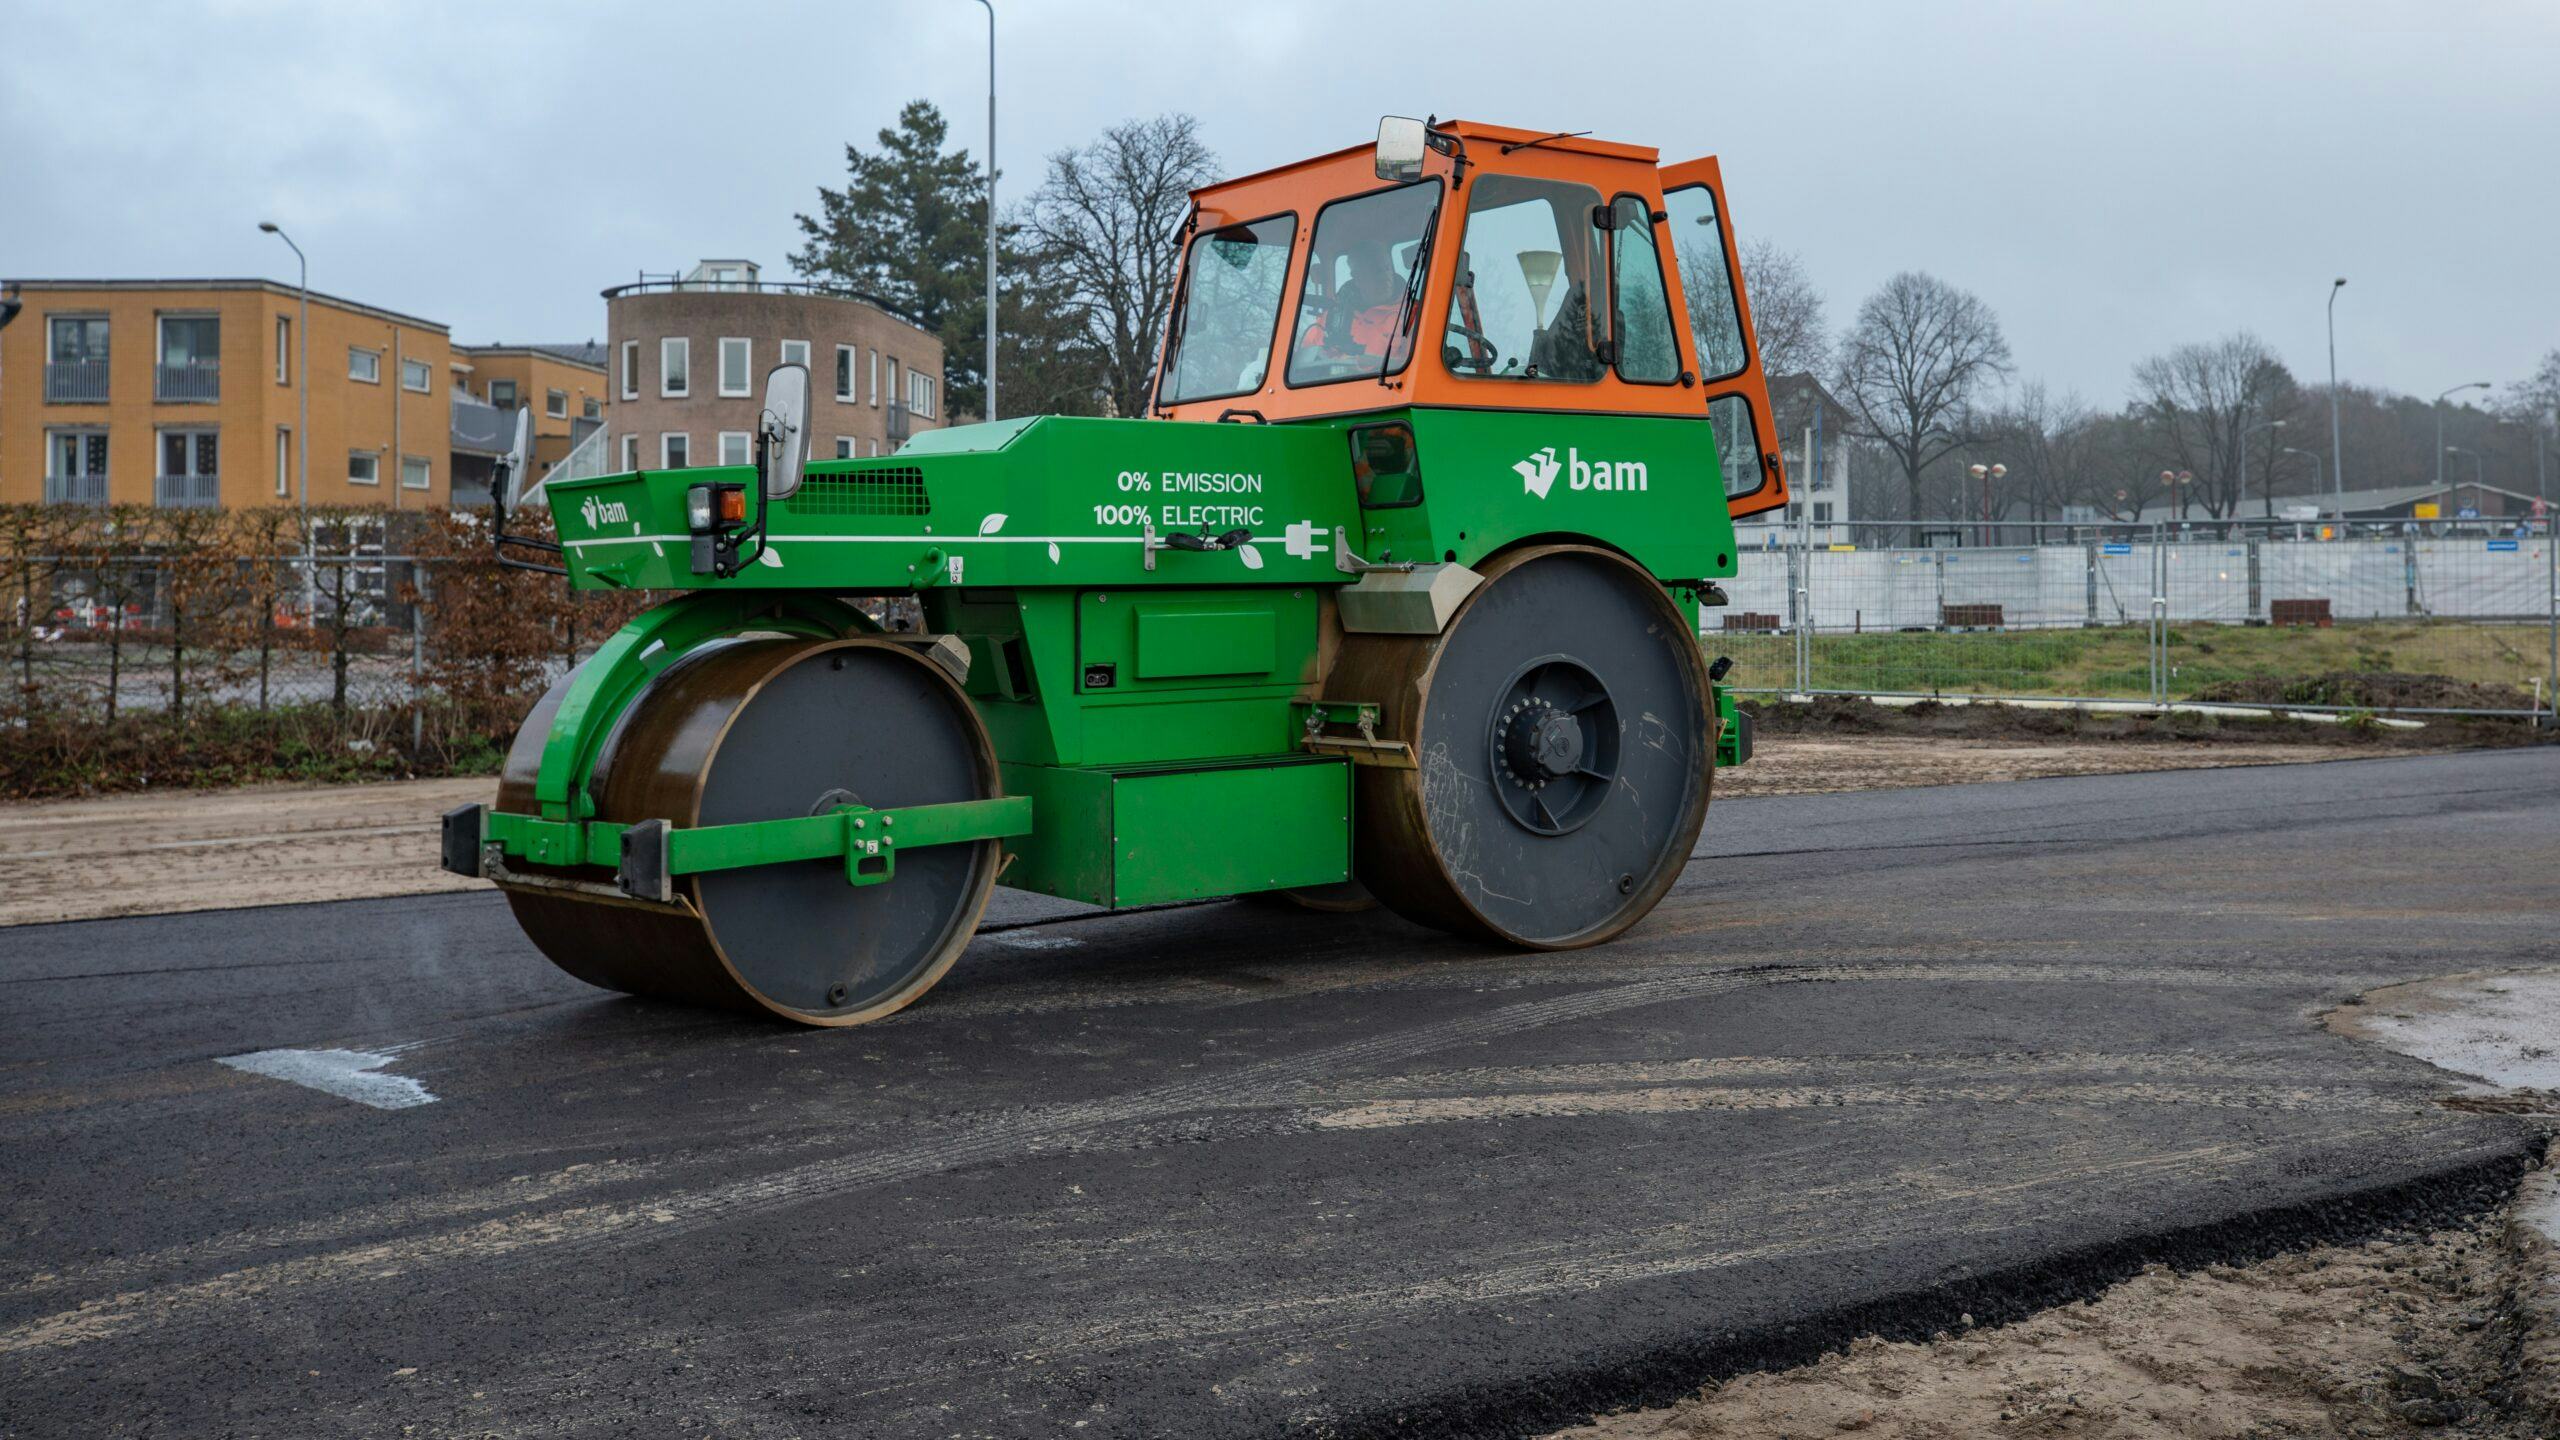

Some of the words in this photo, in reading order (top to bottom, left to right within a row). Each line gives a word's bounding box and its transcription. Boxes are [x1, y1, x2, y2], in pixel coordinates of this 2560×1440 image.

[1569, 447, 1648, 491] bam
[1117, 471, 1151, 492] 0%
[1162, 472, 1262, 493] EMISSION
[594, 495, 628, 524] bam
[1093, 505, 1151, 525] 100%
[1162, 506, 1263, 526] ELECTRIC
